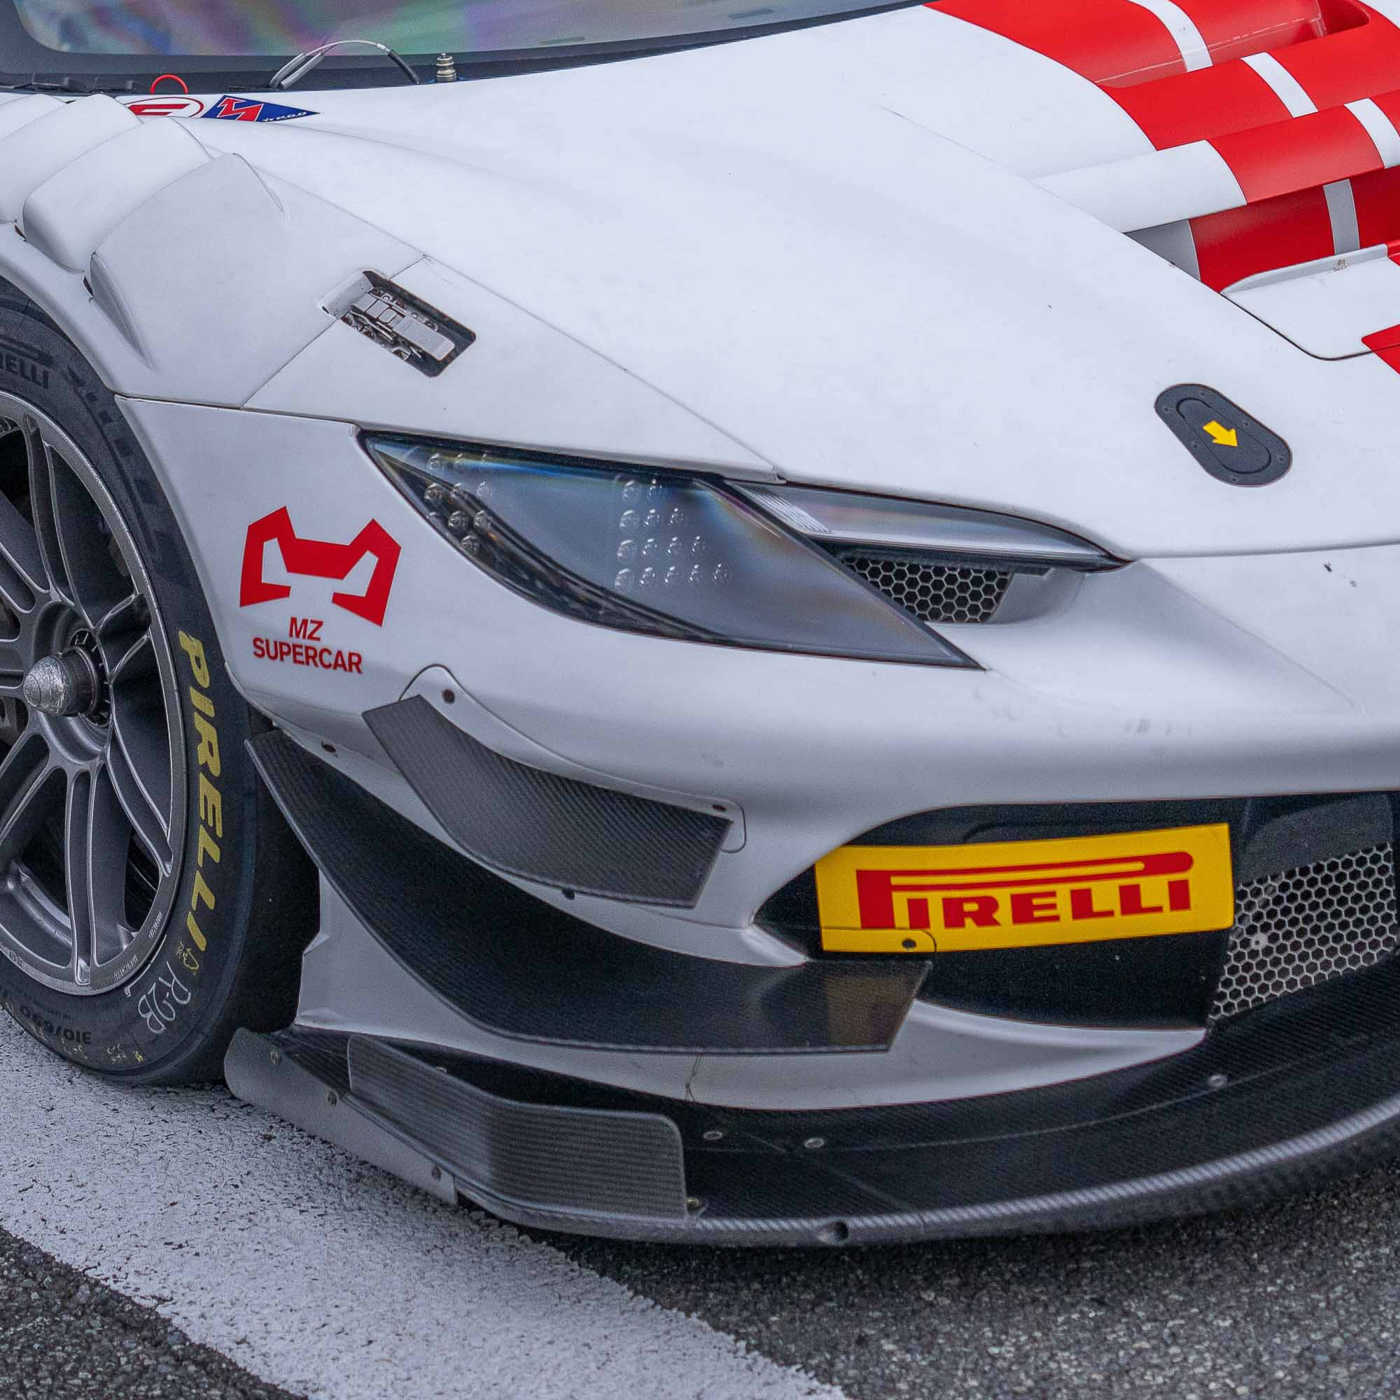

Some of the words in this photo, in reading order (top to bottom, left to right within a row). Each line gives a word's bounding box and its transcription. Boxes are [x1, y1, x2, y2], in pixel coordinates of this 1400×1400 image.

[251, 636, 364, 675] SUPERCAR
[286, 614, 324, 643] MZ
[177, 628, 225, 953] PIRELLI
[854, 850, 1195, 931] PIRELLI
